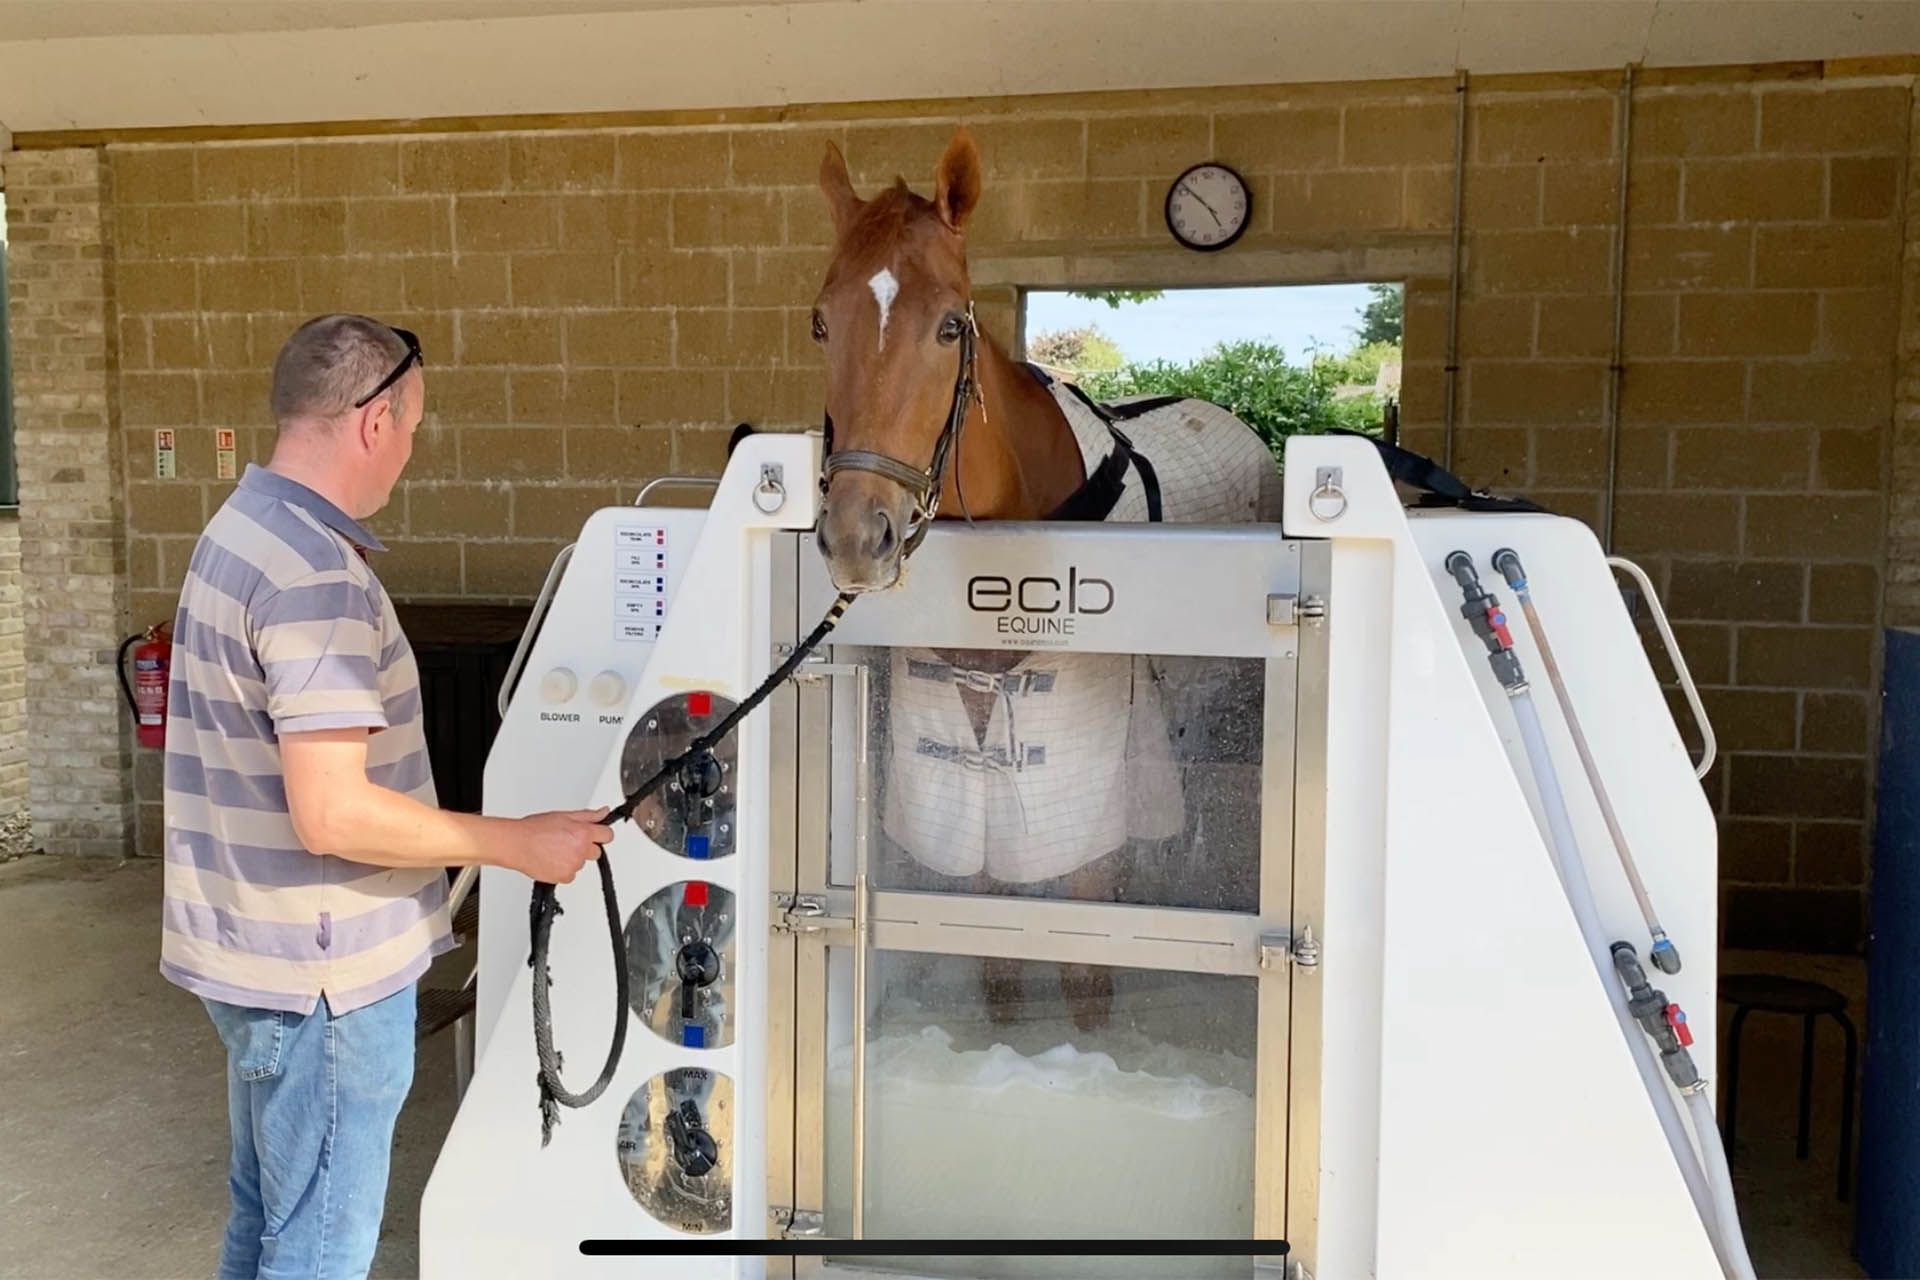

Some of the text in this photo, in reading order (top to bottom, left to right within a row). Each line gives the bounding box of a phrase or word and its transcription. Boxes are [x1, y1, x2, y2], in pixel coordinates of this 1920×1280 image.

[968, 566, 1114, 614] ecb
[997, 616, 1075, 635] EQUINE
[540, 712, 580, 722] BLOWER
[599, 716, 624, 724] PUM
[683, 1070, 708, 1080] MAX
[682, 1223, 703, 1232] MIN
